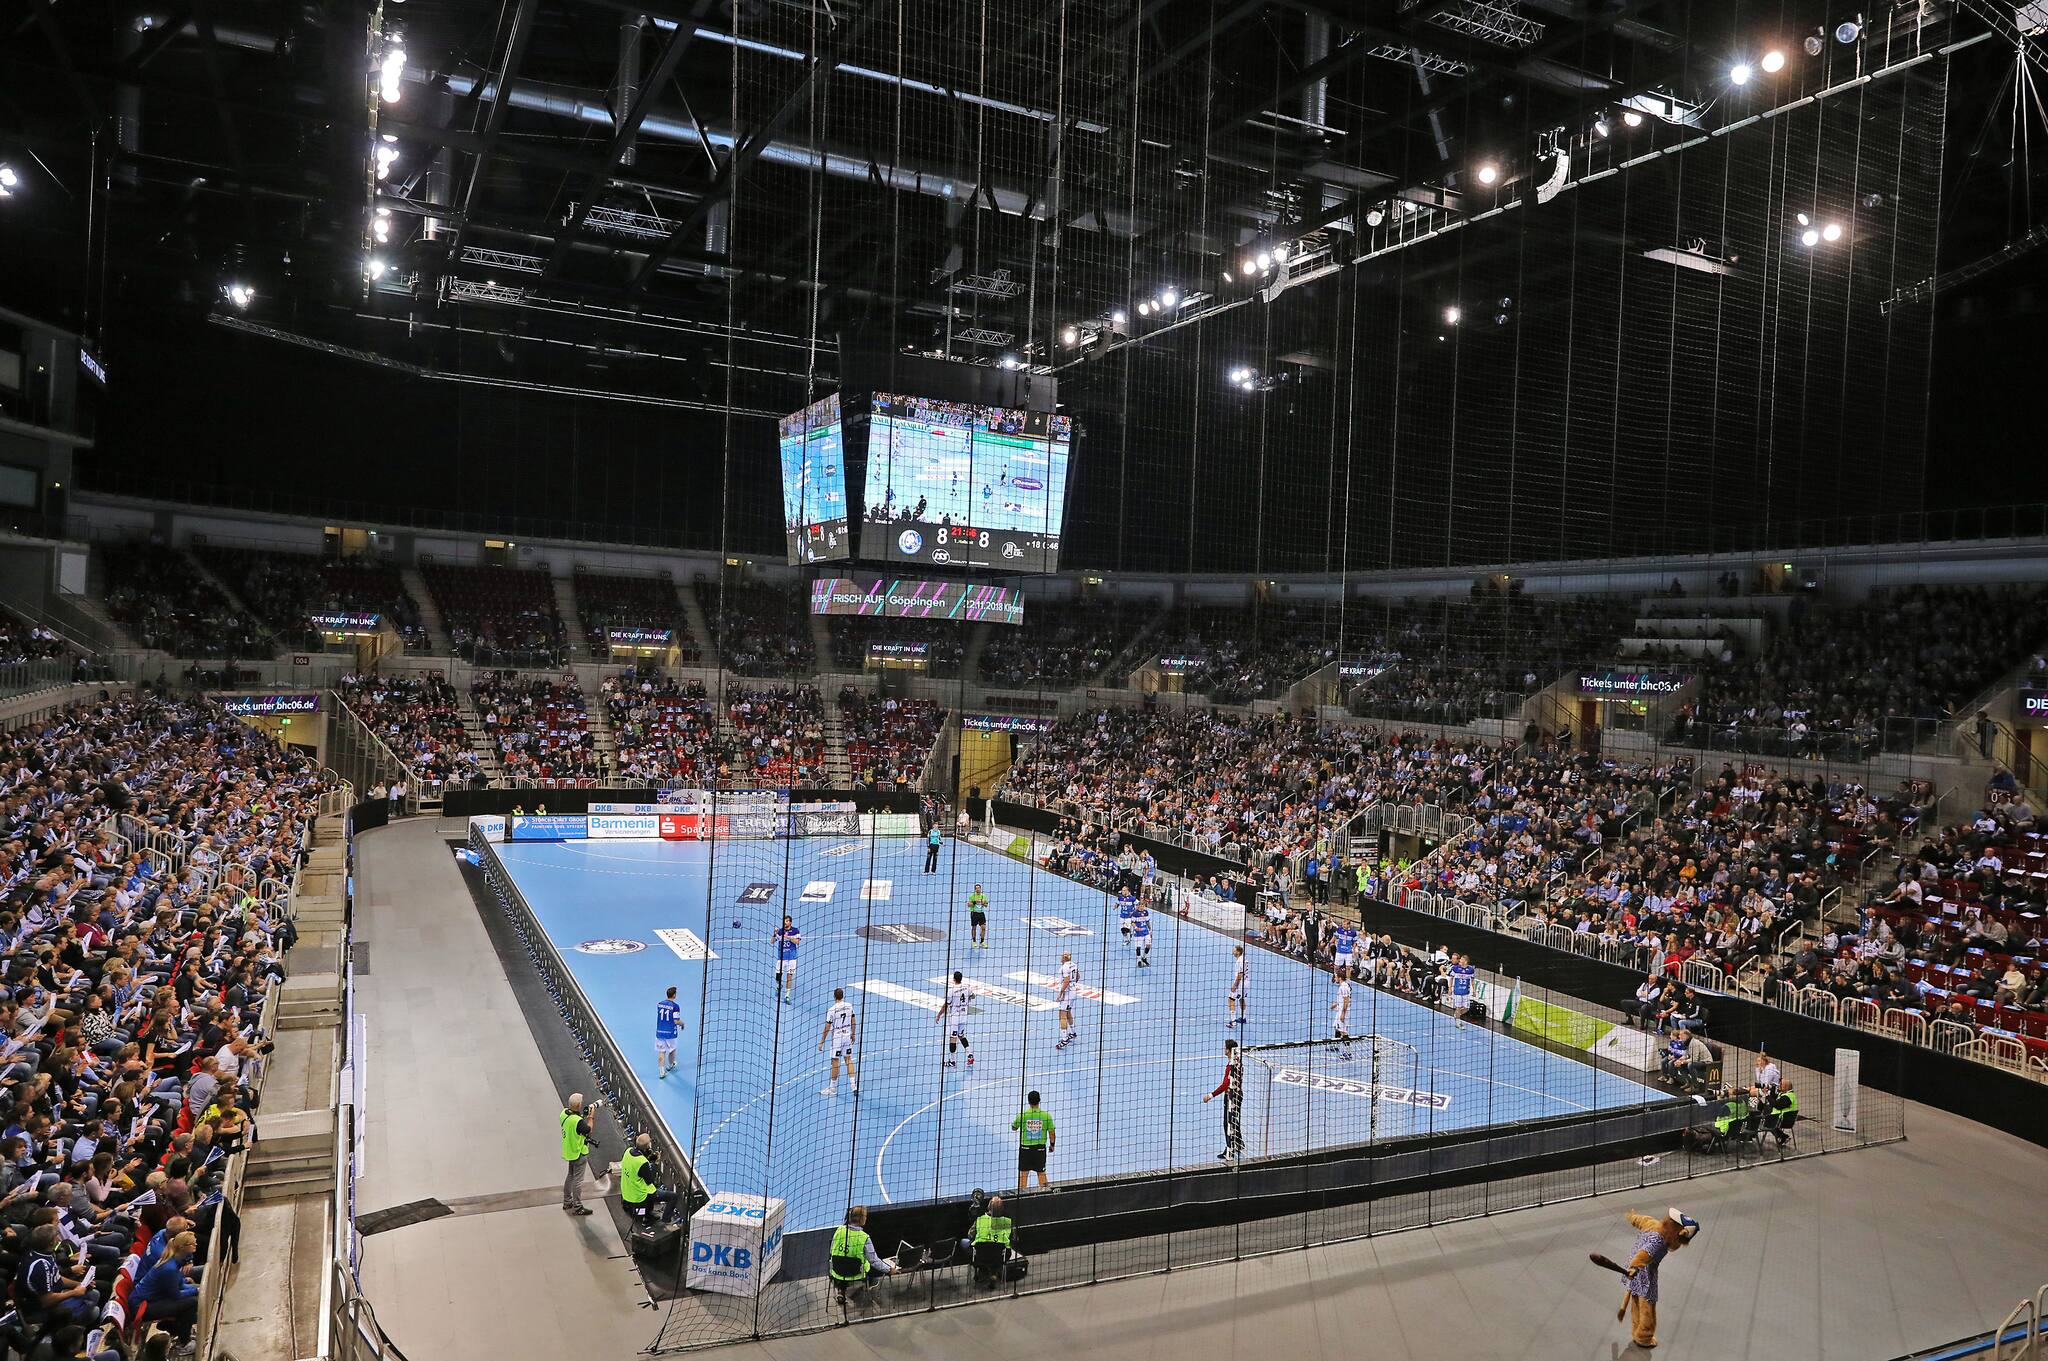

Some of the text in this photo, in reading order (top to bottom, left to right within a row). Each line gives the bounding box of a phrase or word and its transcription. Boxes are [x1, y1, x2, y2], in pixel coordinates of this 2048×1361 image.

[937, 528, 948, 545] 8
[979, 531, 990, 548] 8
[833, 594, 862, 603] FRISCH
[889, 595, 945, 608] Göppingen
[325, 616, 349, 624] KRAFT
[1580, 677, 1612, 688] Tickets
[1614, 681, 1639, 690] unter
[225, 701, 314, 711] ickets unter bhc06.de
[2026, 698, 2048, 710] DIE
[963, 719, 1047, 732] Tickets unter bhc06.de
[487, 823, 504, 832] DKB
[591, 817, 656, 829] Barmenia
[680, 825, 729, 835] Sparkasse
[959, 992, 966, 1003] 4
[659, 1008, 670, 1022] 11
[840, 1013, 847, 1025] 7
[1281, 1071, 1406, 1101] BECKER
[706, 1203, 769, 1219] DKB
[692, 1241, 753, 1269] DKB
[692, 1264, 750, 1280] Das kann Bank
